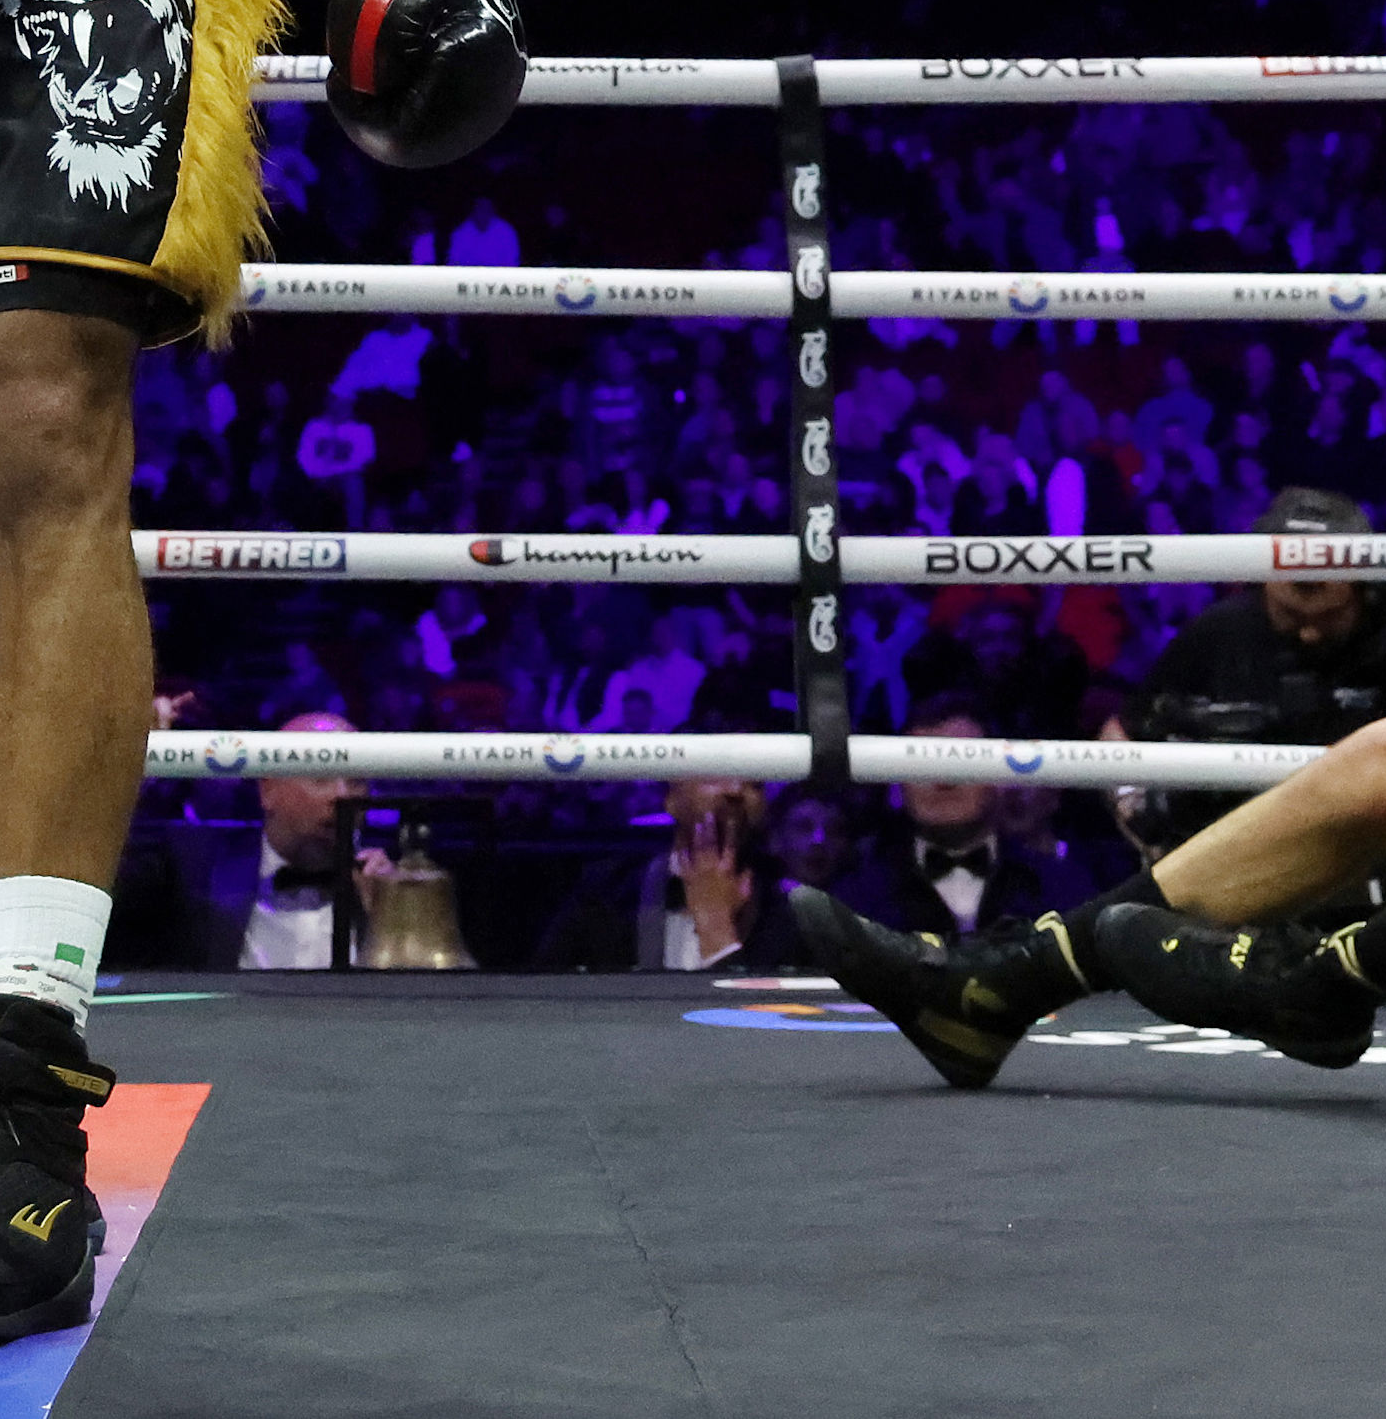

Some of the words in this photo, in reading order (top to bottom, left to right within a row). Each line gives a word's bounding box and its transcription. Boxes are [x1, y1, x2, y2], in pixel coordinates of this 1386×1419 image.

[277, 280, 365, 295] SEASON
[457, 283, 547, 298] RIYADH
[607, 286, 696, 301] SEASON
[913, 288, 1000, 302] RIYADH
[1059, 288, 1146, 302] SEASON
[1234, 287, 1319, 301] RIYADH
[165, 537, 339, 570] BETFRED
[469, 538, 704, 574] Champion
[925, 541, 1154, 575] BOXXER
[258, 749, 350, 763] SEASON
[443, 746, 534, 761] RIYADH
[596, 746, 686, 761] SEASON
[1055, 746, 1143, 761] SEASON
